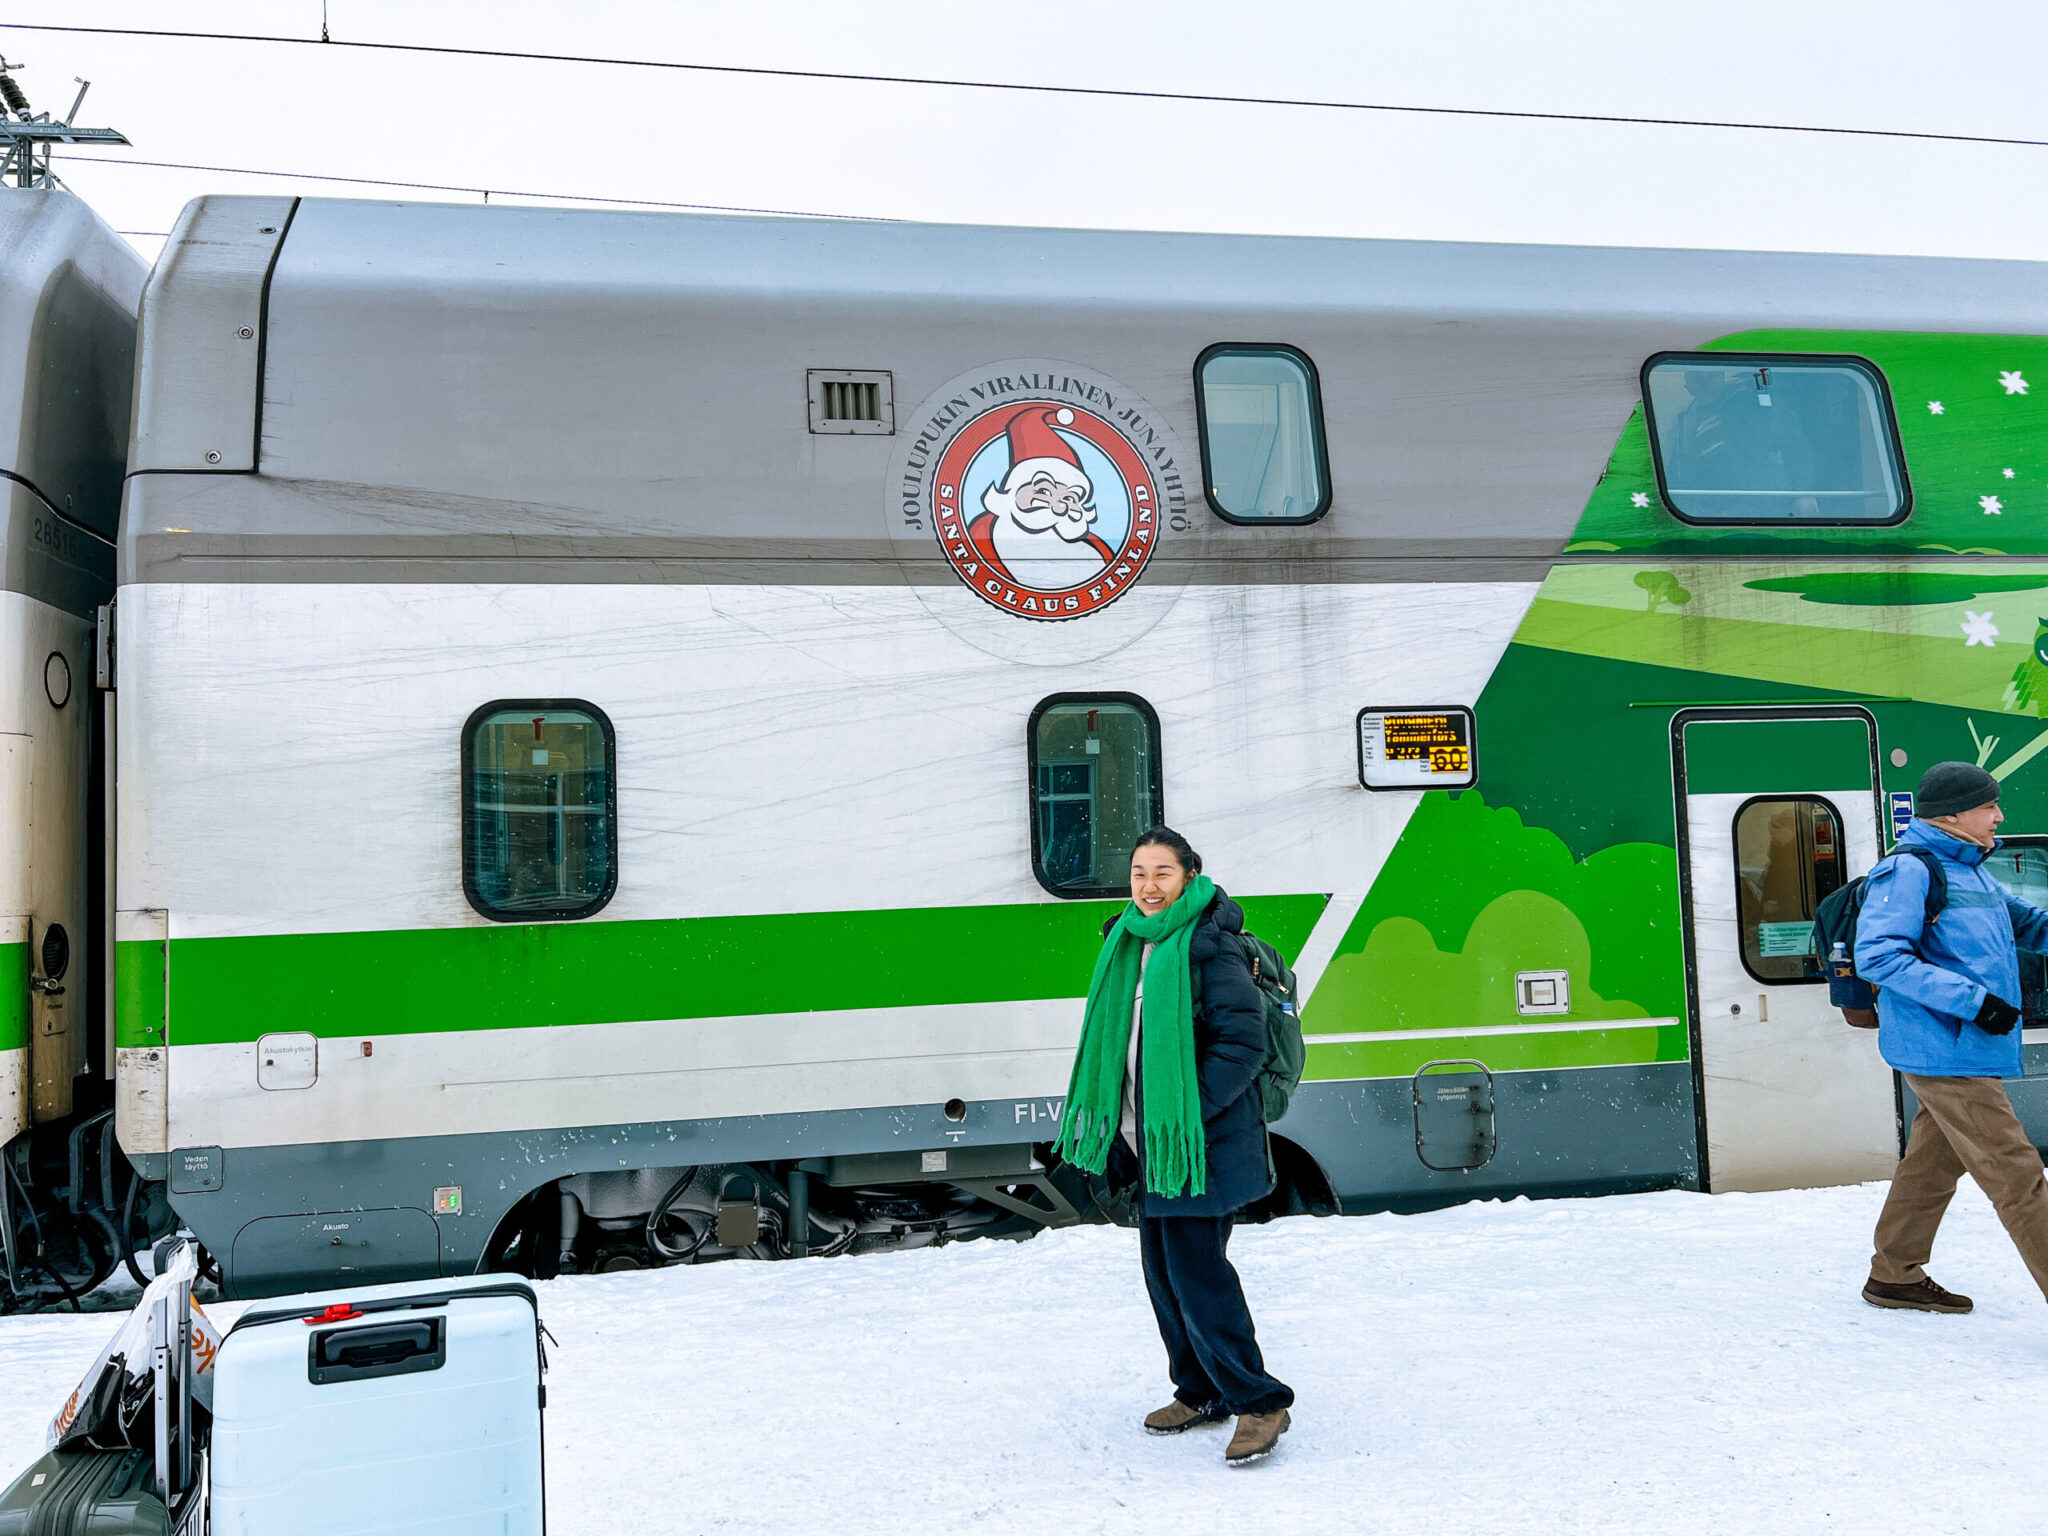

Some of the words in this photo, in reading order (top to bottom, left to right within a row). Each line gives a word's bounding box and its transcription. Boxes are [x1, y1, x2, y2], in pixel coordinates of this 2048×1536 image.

[903, 394, 970, 530] JOULUPUKIN
[970, 373, 1118, 410] VIRALLINEN
[1118, 408, 1192, 532] JUNAYHTIÖ
[940, 484, 980, 578] SANTA
[984, 580, 1080, 611] CLAUS
[1088, 484, 1153, 603] FINLAND
[322, 1223, 349, 1231] Akusto
